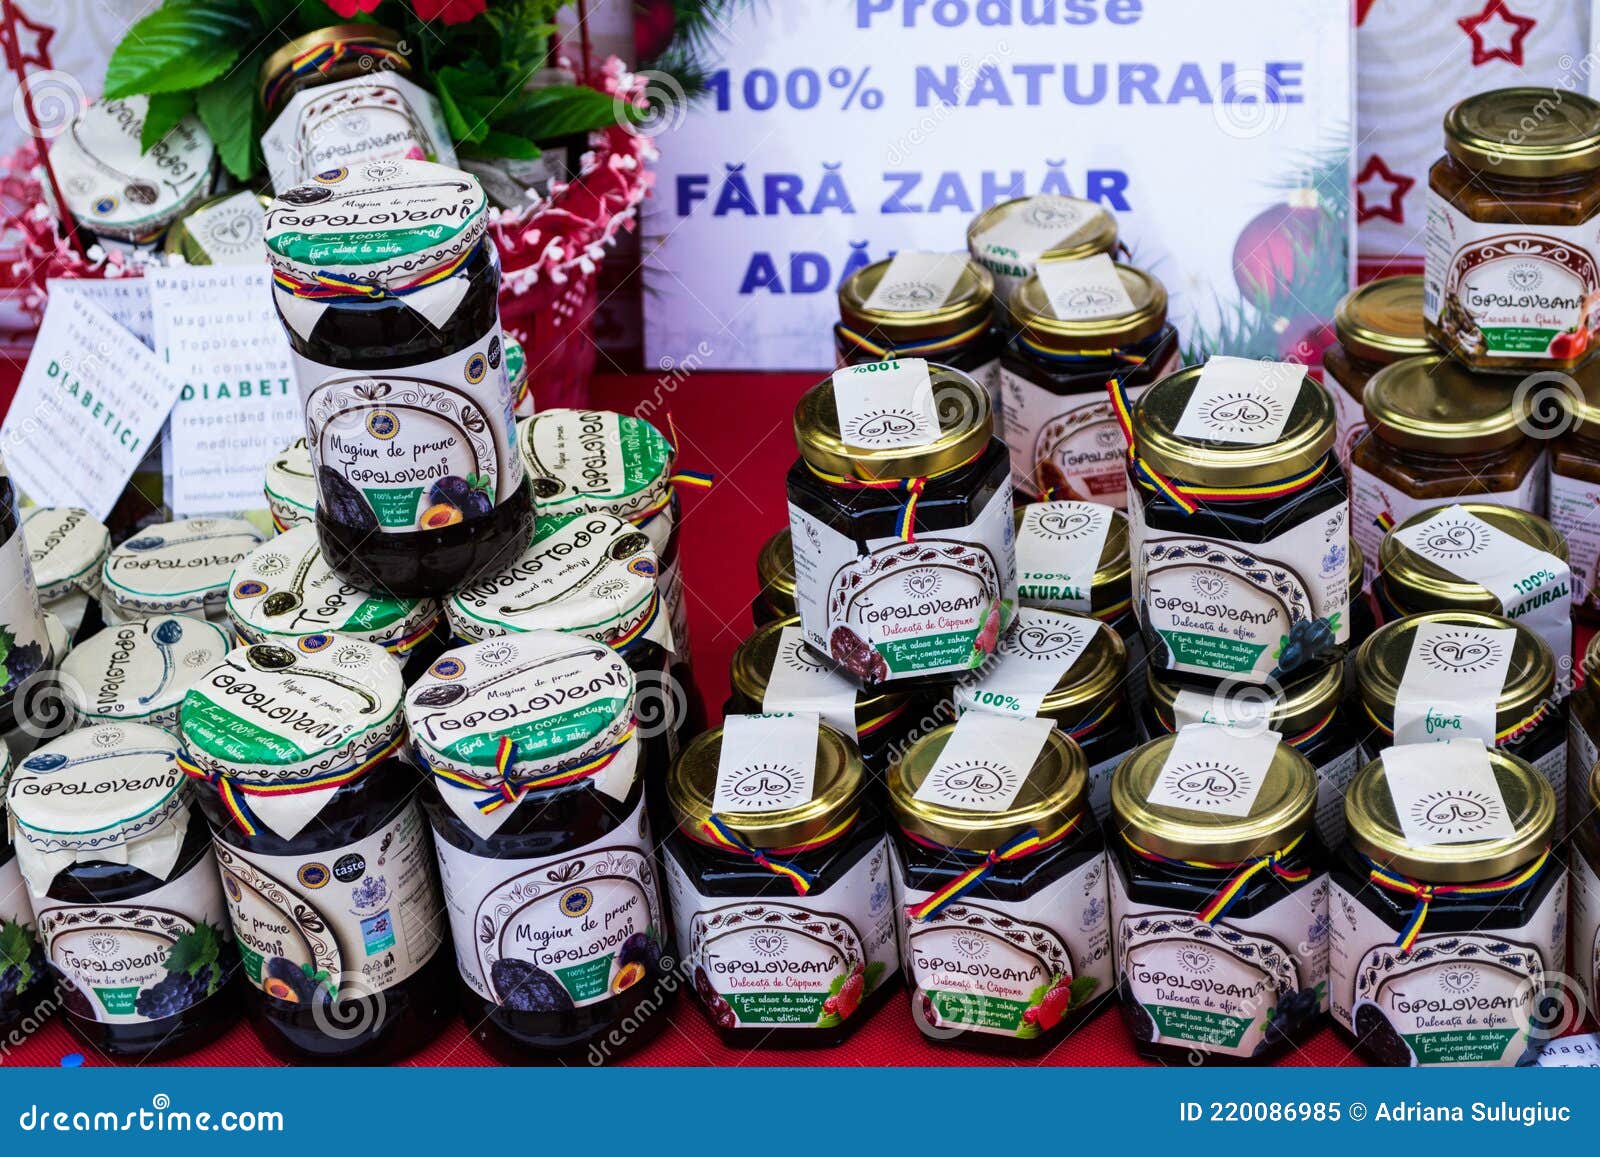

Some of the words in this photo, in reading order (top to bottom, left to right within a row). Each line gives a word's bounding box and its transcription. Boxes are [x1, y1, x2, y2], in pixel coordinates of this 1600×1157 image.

[856, 0, 1143, 28] Produse
[703, 65, 884, 112] 100%
[915, 62, 1304, 107] NATURALE
[675, 162, 856, 216] FĂRĂ
[880, 158, 1132, 214] ZAHĂR
[181, 378, 291, 401] DIABET
[46, 359, 141, 453] DIABETICI
[330, 433, 378, 462] Magiun
[387, 441, 405, 458] de
[413, 436, 457, 462] prune
[1023, 572, 1072, 582] 100%
[1513, 568, 1556, 596] 100%
[1018, 585, 1085, 601] ATURAL
[1506, 582, 1570, 620] NATURAL
[926, 620, 936, 630] de
[1218, 622, 1230, 634] de
[1233, 626, 1257, 641] afine
[972, 689, 1021, 711] 100%
[526, 715, 568, 732] 100%
[573, 699, 618, 720] natural
[226, 716, 259, 739] 100%
[335, 859, 365, 877] taste
[253, 917, 291, 936] prune
[515, 924, 573, 949] Magiun
[581, 915, 598, 933] de
[605, 895, 638, 928] prune
[773, 977, 783, 988] de
[974, 979, 985, 990] de
[1204, 996, 1216, 1008] de
[1466, 1015, 1478, 1025] de
[1481, 1014, 1507, 1028] afine
[1467, 1032, 1477, 1042] de
